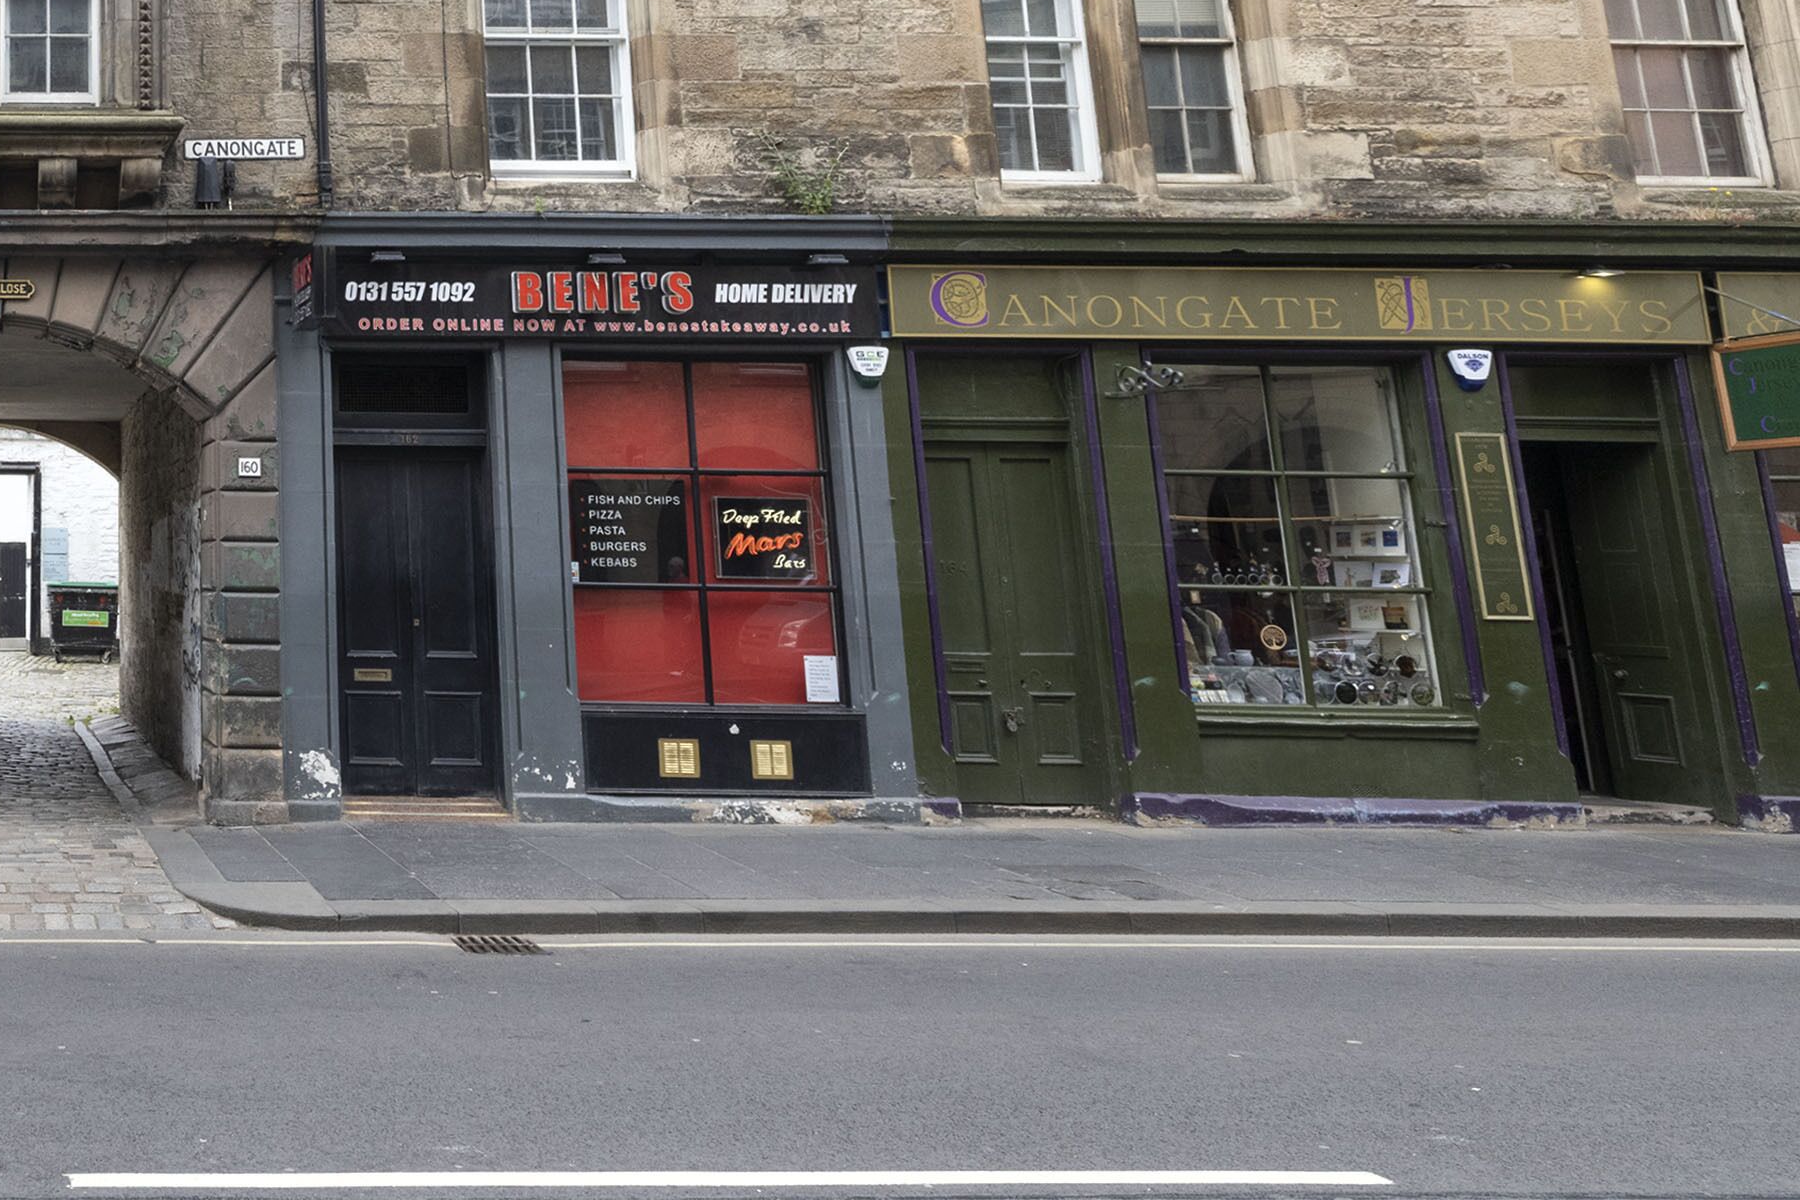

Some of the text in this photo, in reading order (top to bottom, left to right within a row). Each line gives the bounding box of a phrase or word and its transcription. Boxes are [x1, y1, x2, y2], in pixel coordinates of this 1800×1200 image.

[192, 141, 297, 157] CANONGATE
[345, 282, 476, 302] 0131 557 1092
[511, 271, 694, 314] BENE'S
[715, 284, 857, 304] HOME DELIVERY
[930, 271, 1672, 334] CANONGATE JERSEYS
[358, 318, 851, 335] ORDER ONLINE NOW AT www.benestakeaway.co.uk
[241, 461, 259, 473] 160
[588, 495, 681, 505] FISH AND CHIPS
[589, 510, 622, 520] PIZZA
[722, 509, 759, 529] Deep
[590, 526, 626, 535] PASTA
[590, 542, 647, 552] BURGERS
[724, 531, 804, 560] Mars
[591, 558, 637, 568] KEBABS
[773, 554, 806, 569] Bars
